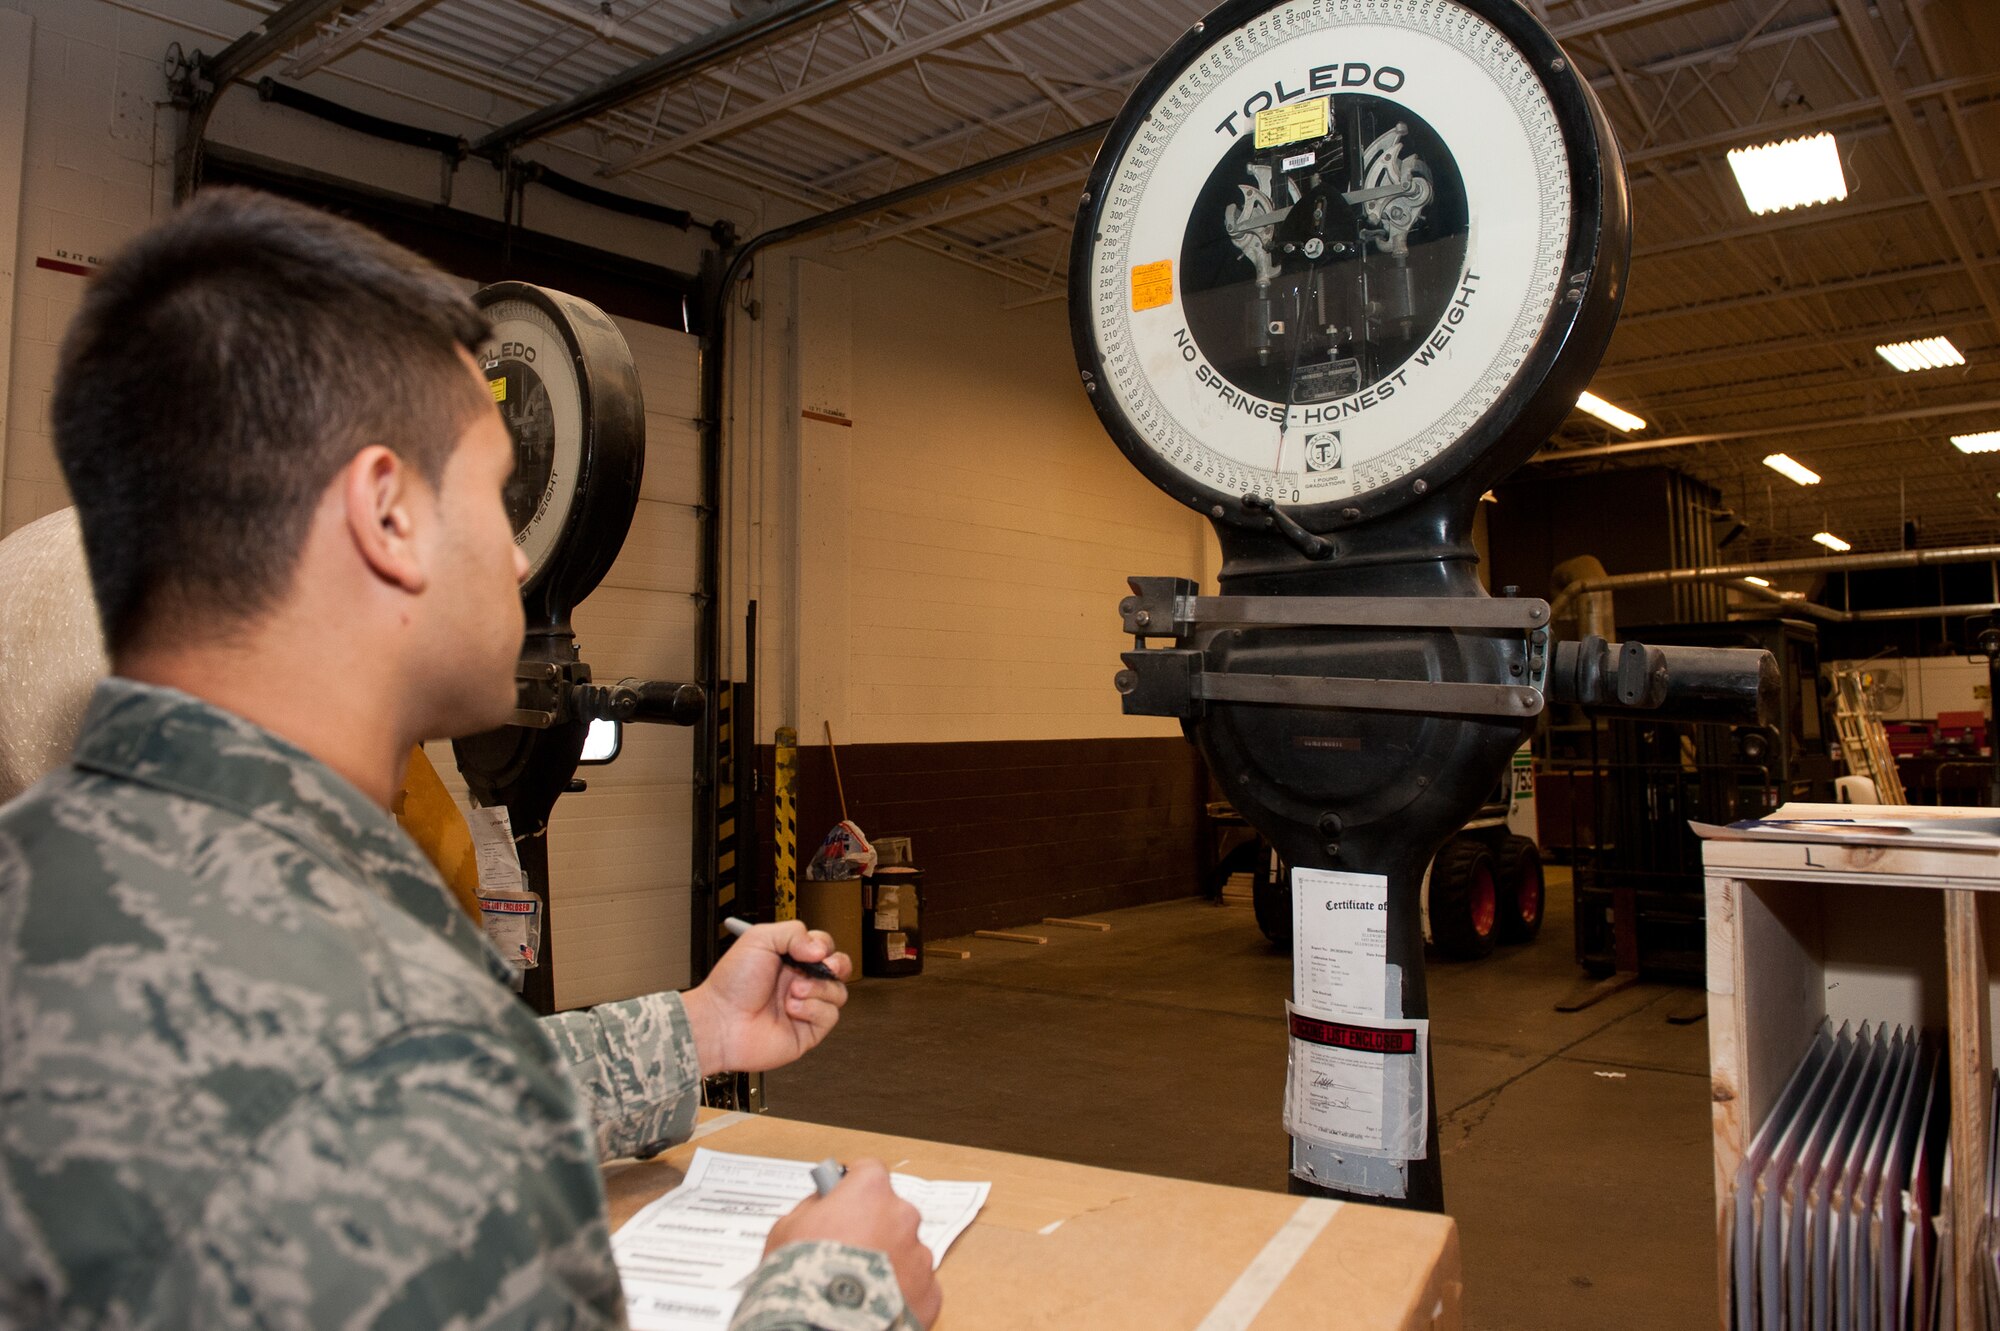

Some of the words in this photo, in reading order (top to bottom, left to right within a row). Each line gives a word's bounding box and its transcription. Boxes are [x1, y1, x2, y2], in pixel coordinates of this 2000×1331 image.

[1326, 0, 1334, 12] 52
[1340, 0, 1348, 10] 53
[1407, 0, 1418, 12] 58
[1434, 1, 1447, 19] 600
[1286, 9, 1294, 24] 490
[1296, 10, 1311, 21] 500
[1447, 6, 1460, 24] 610
[1458, 12, 1472, 30] 620
[1259, 21, 1268, 36] 470
[1273, 15, 1281, 30] 480
[1470, 19, 1485, 37] 630
[1247, 28, 1256, 43] 460
[1482, 27, 1497, 45] 640
[1234, 36, 1245, 51] 450
[1492, 36, 1508, 53] 650
[1222, 45, 1233, 59] 440
[1210, 54, 1222, 68] 430
[1200, 63, 1211, 78] 420
[1189, 74, 1200, 87] 410
[1179, 84, 1191, 98] 400
[1528, 82, 1542, 96] 69
[1169, 95, 1181, 109] 390
[1214, 62, 1405, 137] TOLEDO
[1534, 96, 1548, 108] 70
[1160, 107, 1172, 120] 380
[1540, 110, 1552, 121] 71
[1152, 119, 1165, 131] 370
[1546, 124, 1559, 135] 72
[1144, 131, 1157, 143] 360
[1137, 144, 1150, 155] 350
[1551, 138, 1564, 149] 73
[1130, 157, 1143, 168] 340
[1555, 153, 1568, 164] 74
[1124, 170, 1137, 181] 330
[1558, 170, 1569, 180] 75
[1119, 183, 1132, 194] 320
[1559, 184, 1571, 195] 76
[1114, 197, 1127, 207] 310
[1560, 201, 1571, 211] 77
[1110, 211, 1123, 220] 300
[1560, 218, 1570, 227] 78
[1107, 225, 1120, 233] 290
[1556, 250, 1566, 259] 80
[1101, 266, 1114, 274] 260
[1100, 279, 1113, 288] 250
[1100, 292, 1113, 301] 240
[1101, 305, 1114, 315] 230
[1102, 318, 1115, 328] 220
[1104, 330, 1117, 341] 210
[1107, 342, 1120, 354] 200
[1174, 328, 1196, 362] NO
[1196, 364, 1285, 422] SPRINGS
[1305, 370, 1407, 424] HONEST
[1414, 268, 1480, 367] WEIGHT
[478, 342, 536, 368] OLEDO
[1110, 355, 1124, 366] 190
[1114, 366, 1128, 379] 180
[1119, 378, 1132, 390] 170
[1125, 389, 1138, 401] 160
[1131, 400, 1144, 413] 150
[1137, 410, 1150, 424] 140
[1145, 420, 1158, 434] 130
[1152, 429, 1166, 444] 120
[1162, 438, 1174, 452] 110
[1170, 446, 1183, 460] 100
[1183, 454, 1193, 464] 90
[1194, 461, 1203, 472] 80
[1407, 459, 1418, 471] 96
[1204, 467, 1214, 478] 70
[1394, 466, 1404, 477] 97
[1217, 472, 1225, 484] 60
[1227, 477, 1236, 488] 50
[1305, 480, 1346, 488] GRADUATIONS
[1367, 476, 1376, 489] 99
[1380, 472, 1390, 484] 98
[1240, 482, 1248, 492] 40
[1252, 484, 1261, 496] 30
[1265, 487, 1273, 498] 20
[1279, 489, 1287, 498] 10
[1292, 490, 1299, 503] 0
[514, 526, 531, 546] EST
[533, 469, 558, 525] WEIGHT
[1326, 900, 1374, 910] Certificate
[1327, 1029, 1346, 1043] LIST
[1349, 1031, 1402, 1049] ENCLOSED
